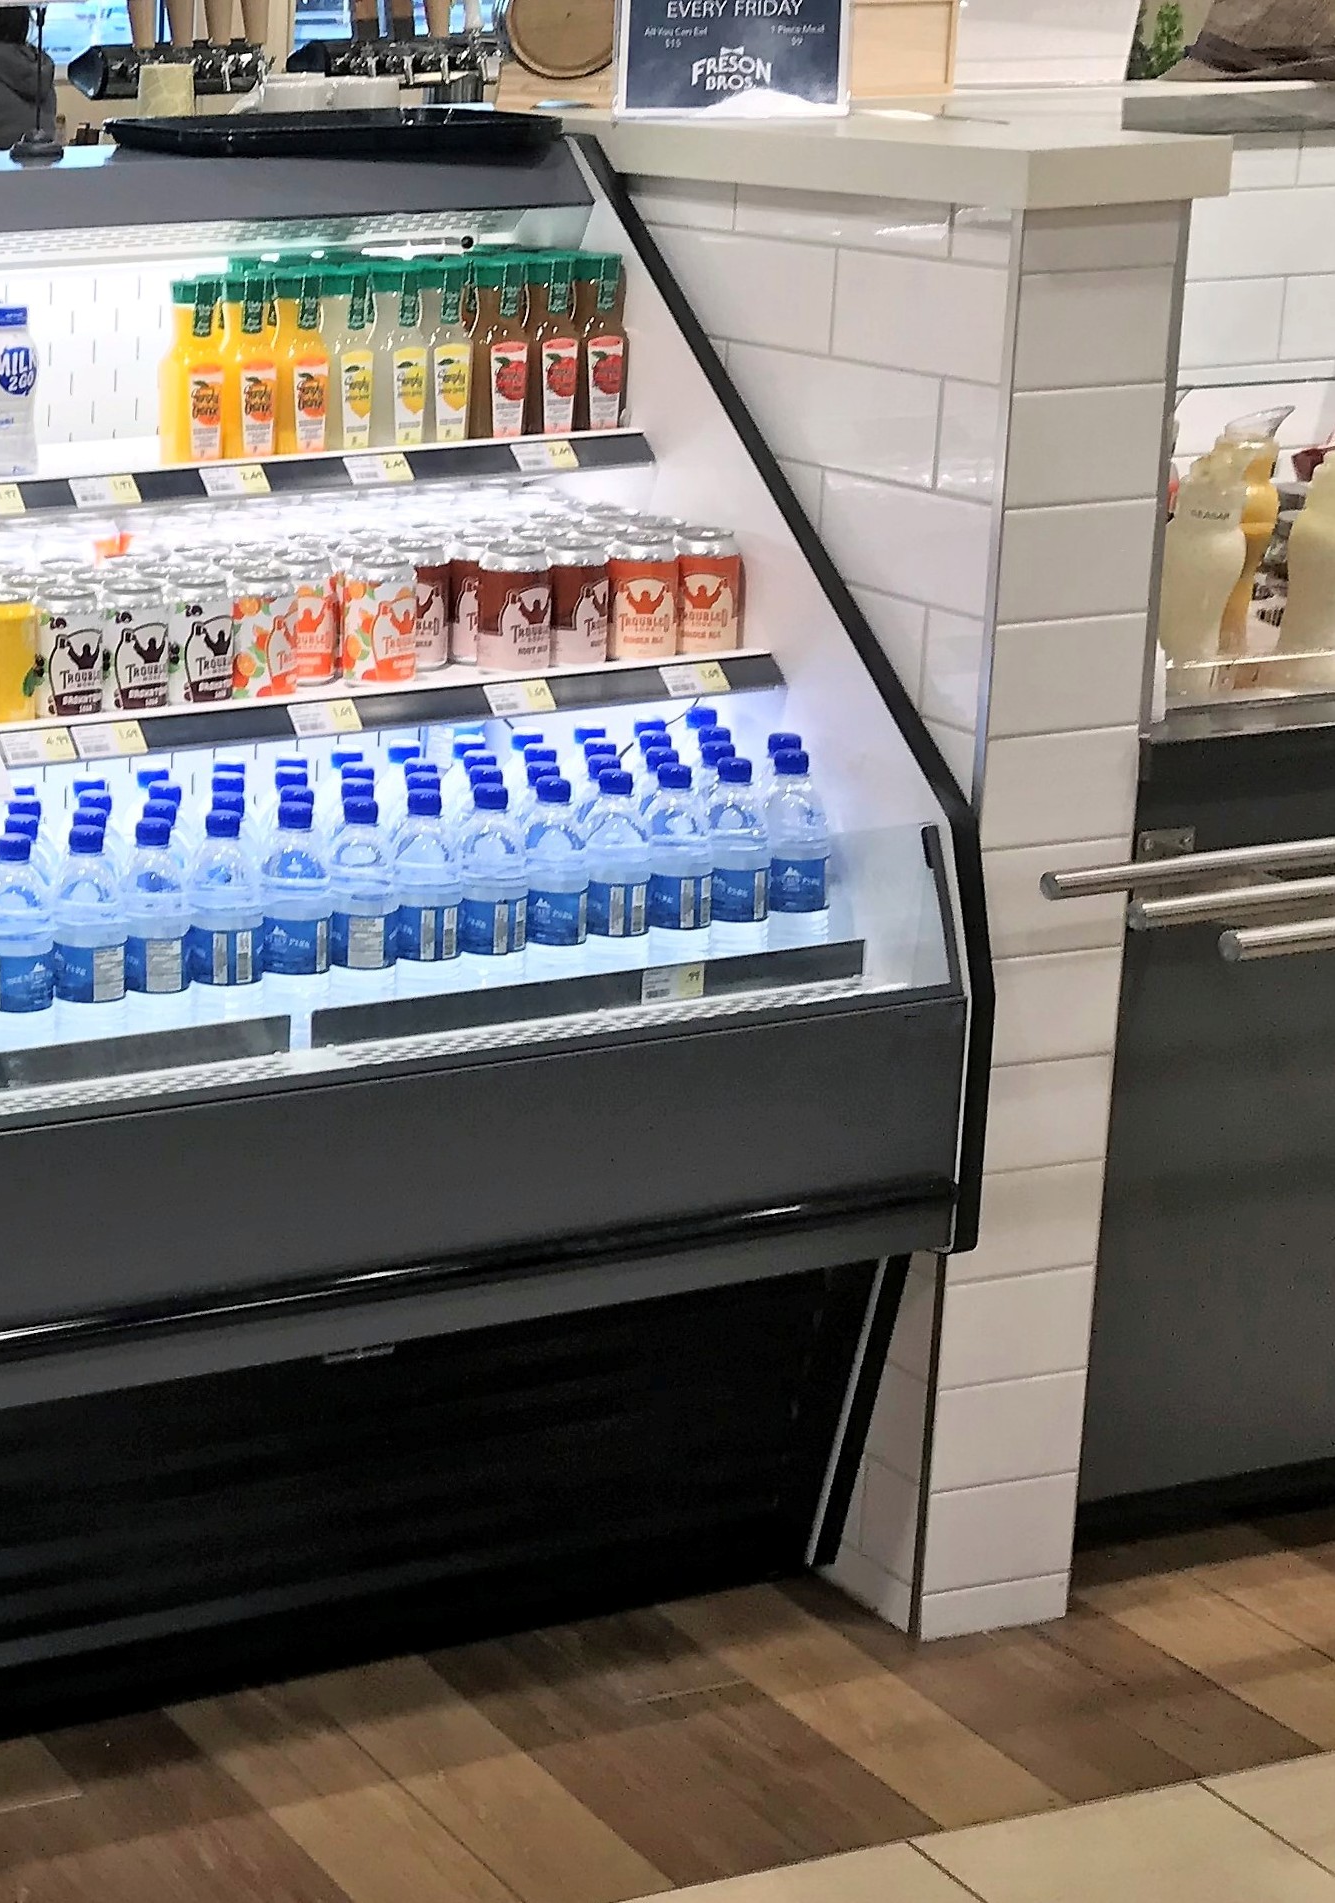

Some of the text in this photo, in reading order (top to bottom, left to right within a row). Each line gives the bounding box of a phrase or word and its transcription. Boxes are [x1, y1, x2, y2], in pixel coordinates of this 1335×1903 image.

[667, 0, 803, 18] EVERY FRIDAY
[691, 55, 773, 86] FRESON
[705, 74, 757, 91] BROS.
[8, 371, 35, 392] 2GO
[619, 613, 670, 634] TROUBLED
